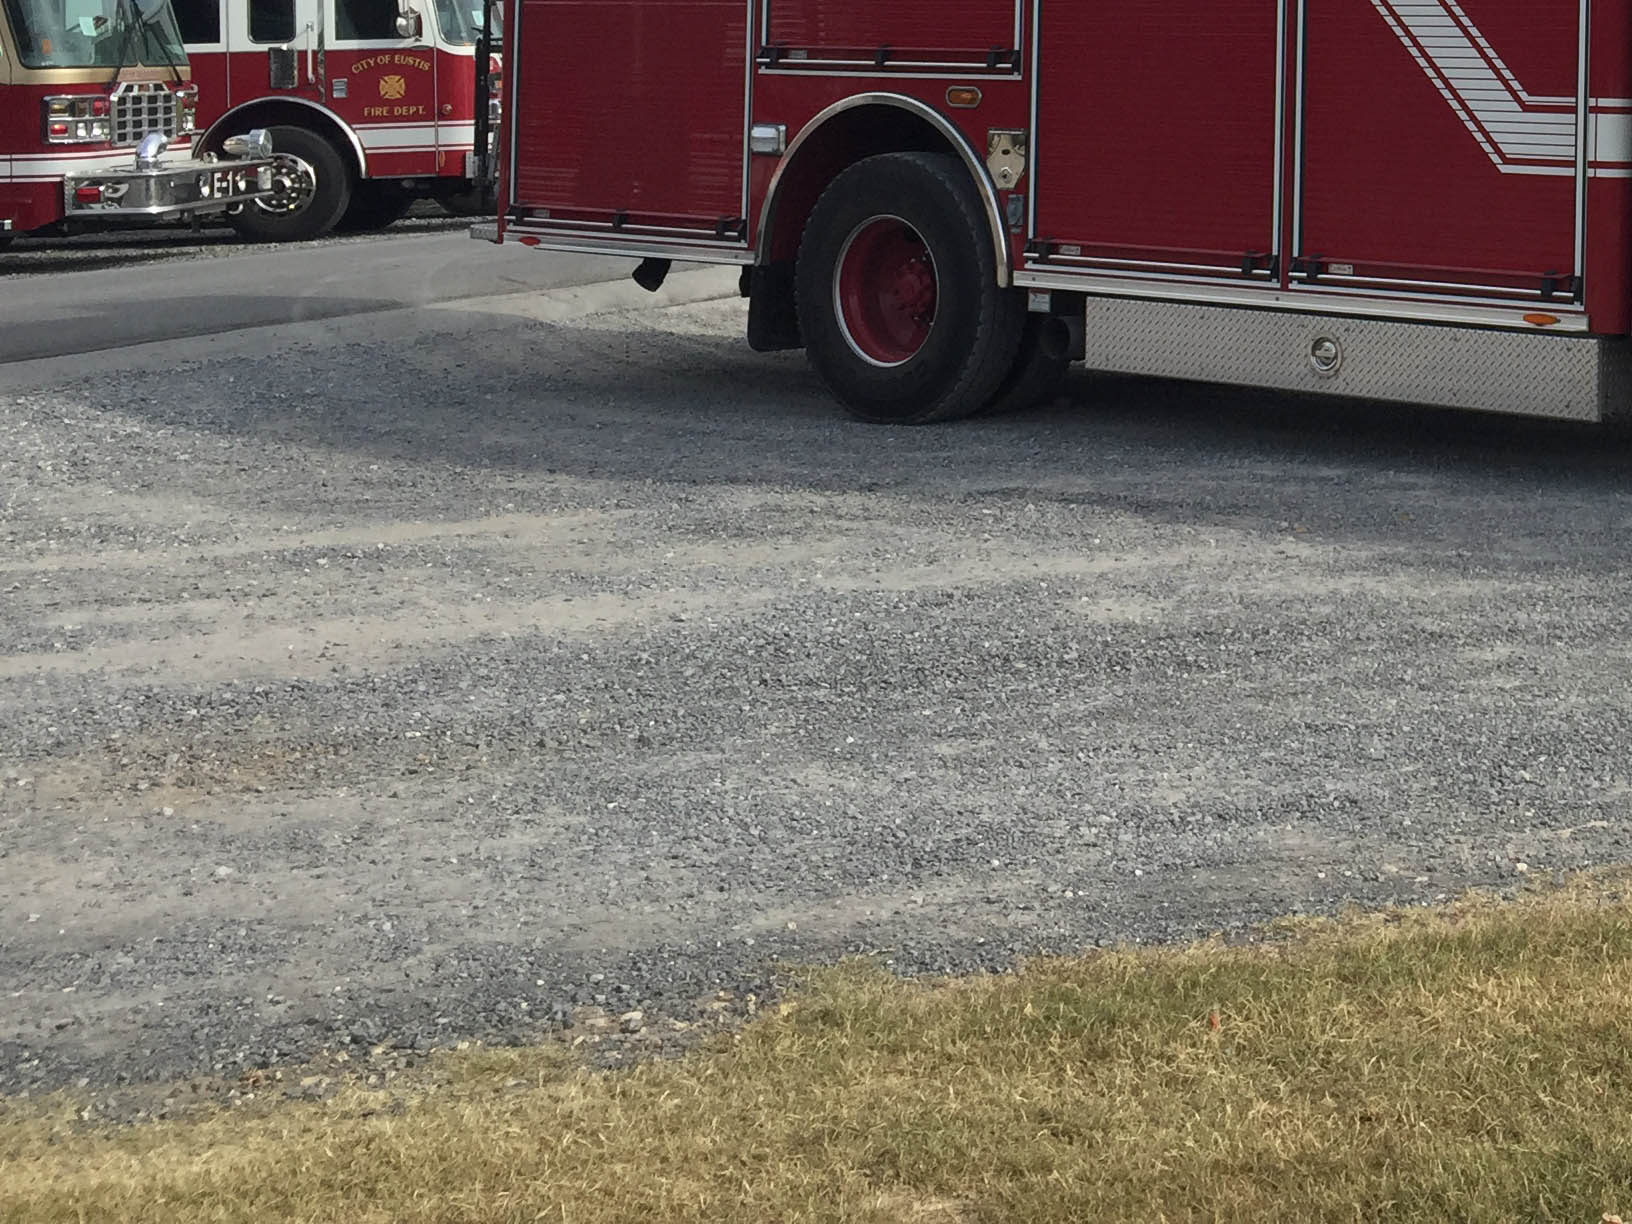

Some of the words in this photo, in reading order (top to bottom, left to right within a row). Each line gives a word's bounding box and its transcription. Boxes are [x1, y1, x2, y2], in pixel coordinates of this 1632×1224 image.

[351, 57, 376, 74] CITY
[377, 55, 392, 65] OF
[394, 55, 431, 71] EUSTIS
[363, 106, 390, 117] FIRE
